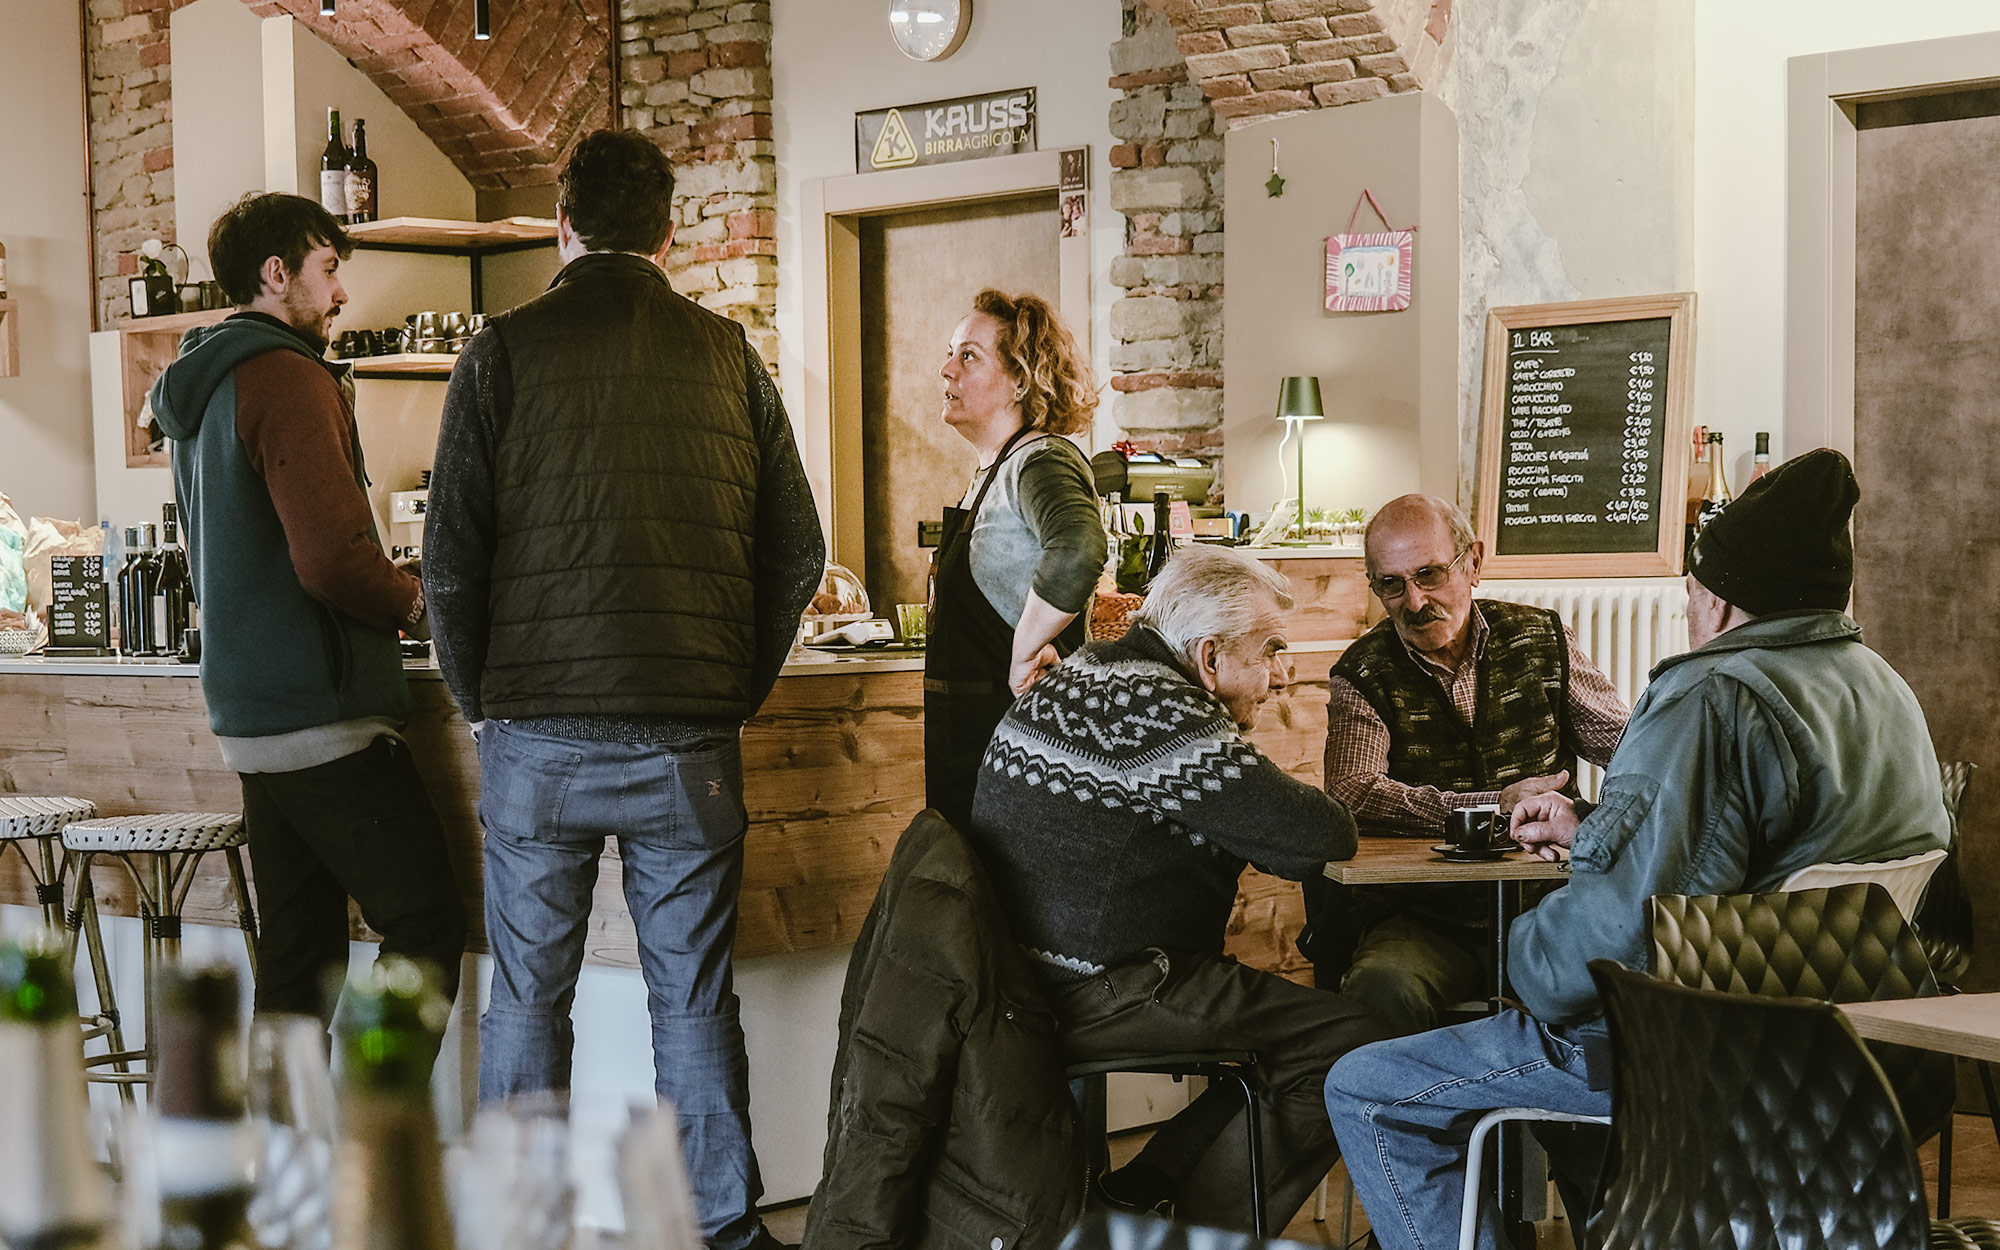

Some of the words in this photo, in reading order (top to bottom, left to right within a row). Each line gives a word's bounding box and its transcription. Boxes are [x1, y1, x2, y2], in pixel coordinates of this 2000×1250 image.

[937, 33, 945, 47] 5
[925, 97, 1028, 139] KAUSS
[1513, 332, 1525, 348] IL
[1530, 331, 1555, 347] BAR
[1512, 381, 1564, 393] MAROCCHINO
[1511, 393, 1559, 404] CAPPUCCINO
[1531, 403, 1573, 415] MACCHIATO
[1509, 442, 1533, 452] TORTA
[1508, 465, 1549, 476] FOCACCINA
[1507, 475, 1549, 487] FOCACCINA
[1551, 474, 1584, 484] FARCITA
[1505, 488, 1530, 499] TOAST
[1504, 515, 1538, 526] FOCACCIA
[1565, 513, 1597, 524] FARCITA
